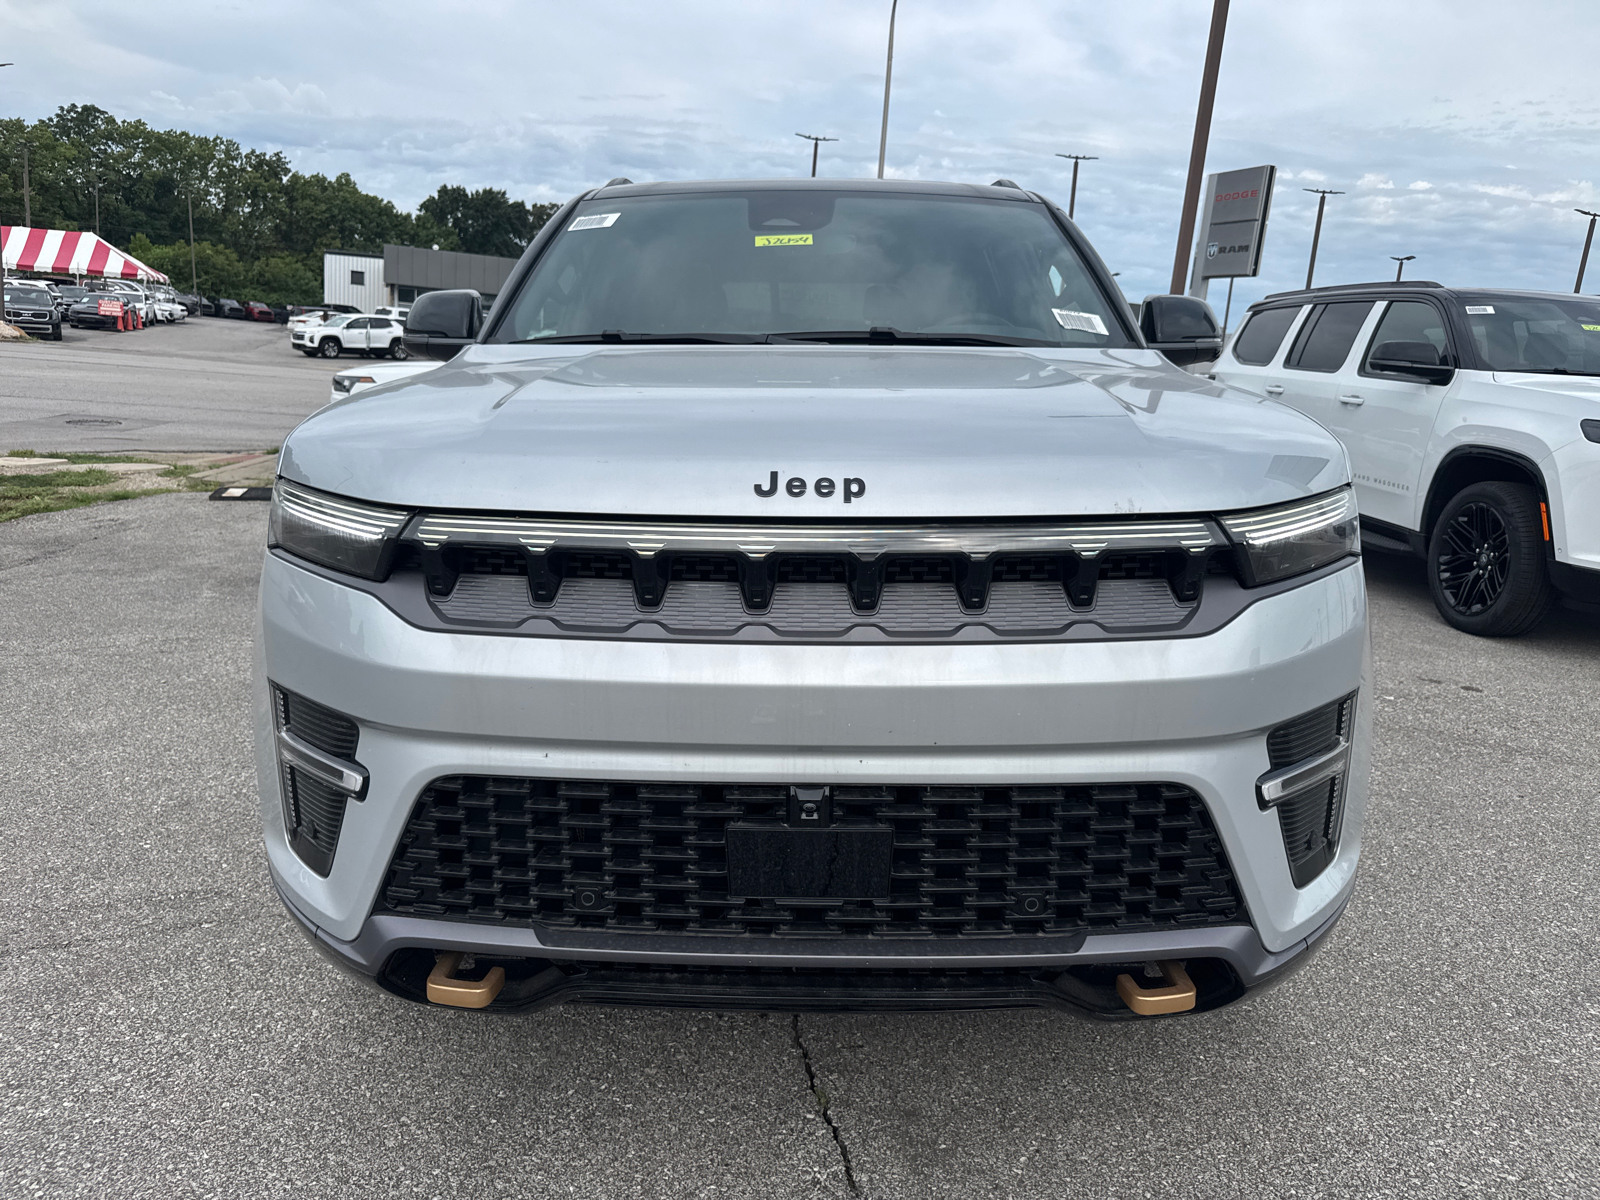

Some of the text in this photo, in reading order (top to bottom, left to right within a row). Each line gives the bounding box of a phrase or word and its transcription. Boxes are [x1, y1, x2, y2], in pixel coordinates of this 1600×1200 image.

[1215, 189, 1258, 202] DODGE
[1219, 244, 1250, 254] RAM
[754, 471, 866, 503] Jeep
[1373, 477, 1410, 491] WAGONEER
